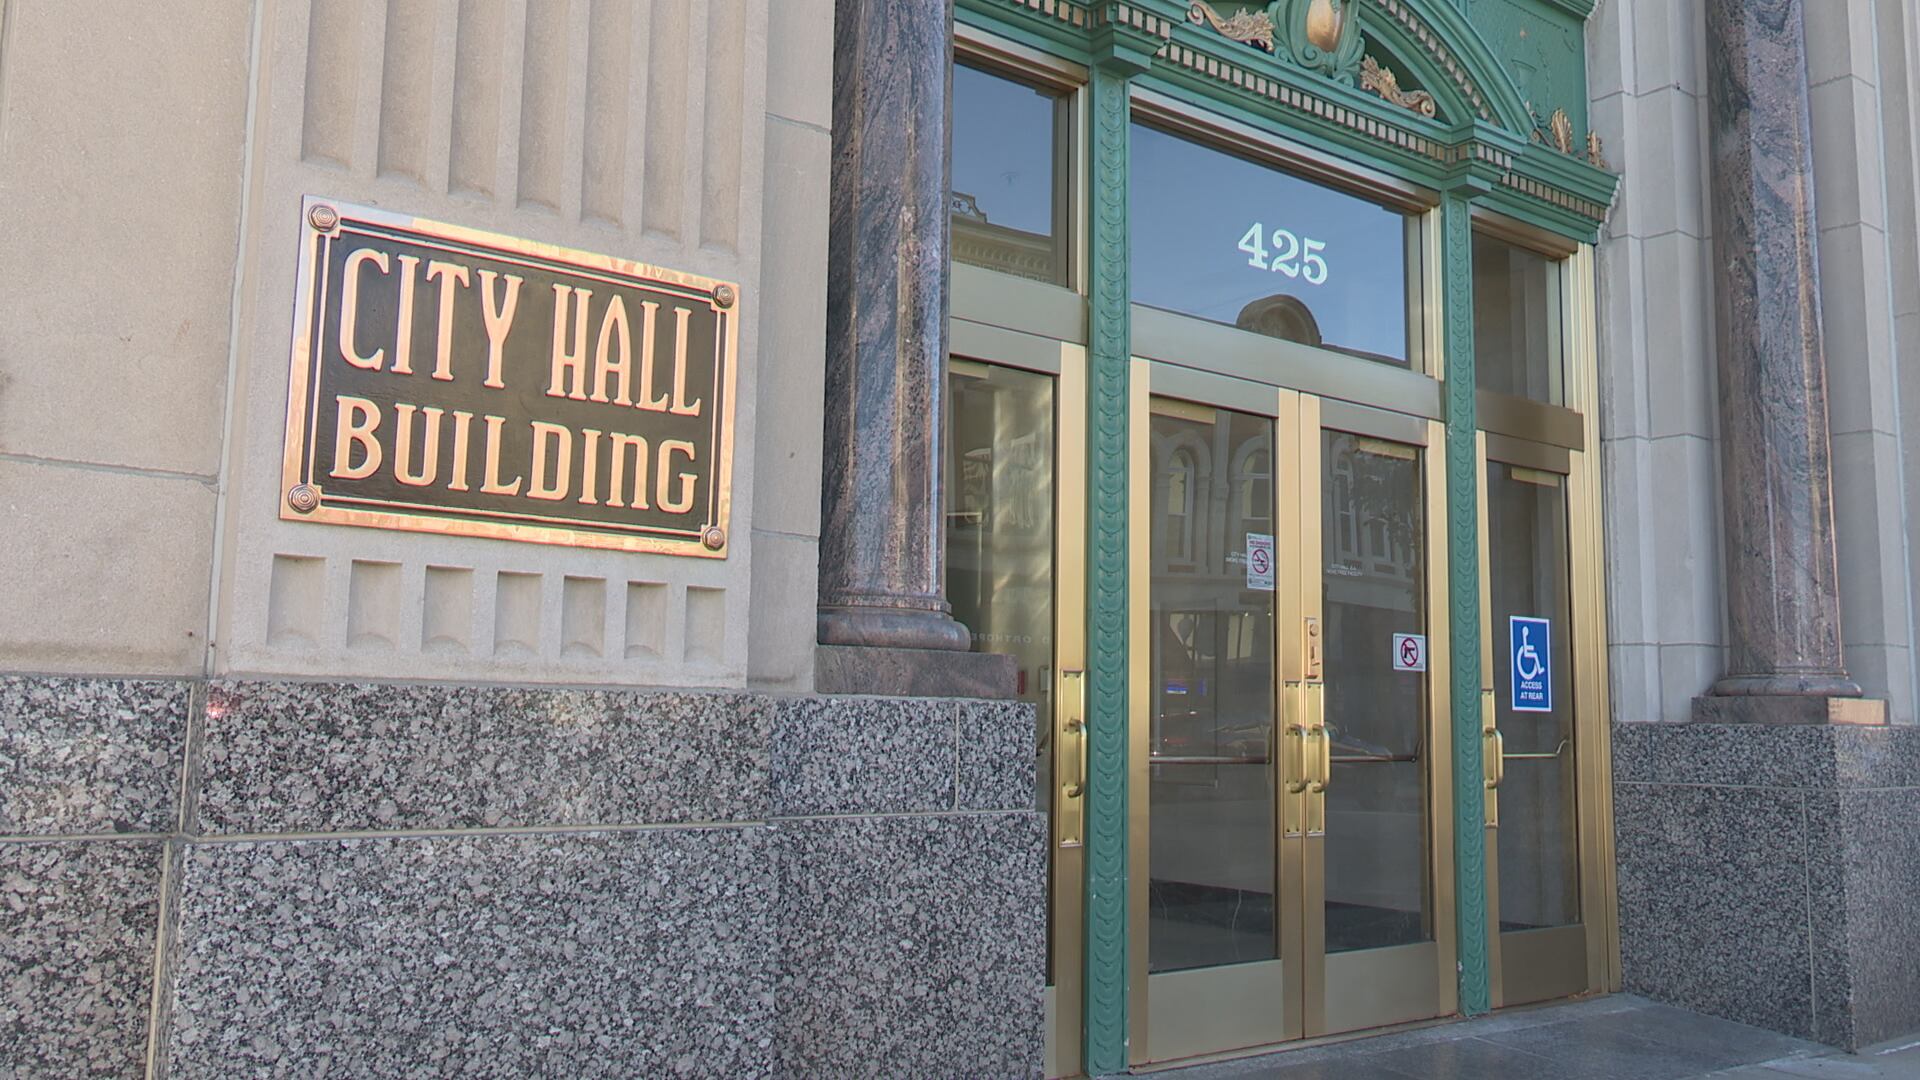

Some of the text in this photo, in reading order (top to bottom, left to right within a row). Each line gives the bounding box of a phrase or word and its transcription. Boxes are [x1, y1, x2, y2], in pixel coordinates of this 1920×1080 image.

[1238, 222, 1328, 285] 425
[338, 247, 701, 416] CITY HALL
[329, 394, 698, 514] BUILDING
[1520, 681, 1543, 690] ACCESS
[1520, 691, 1544, 700] AT REAR
